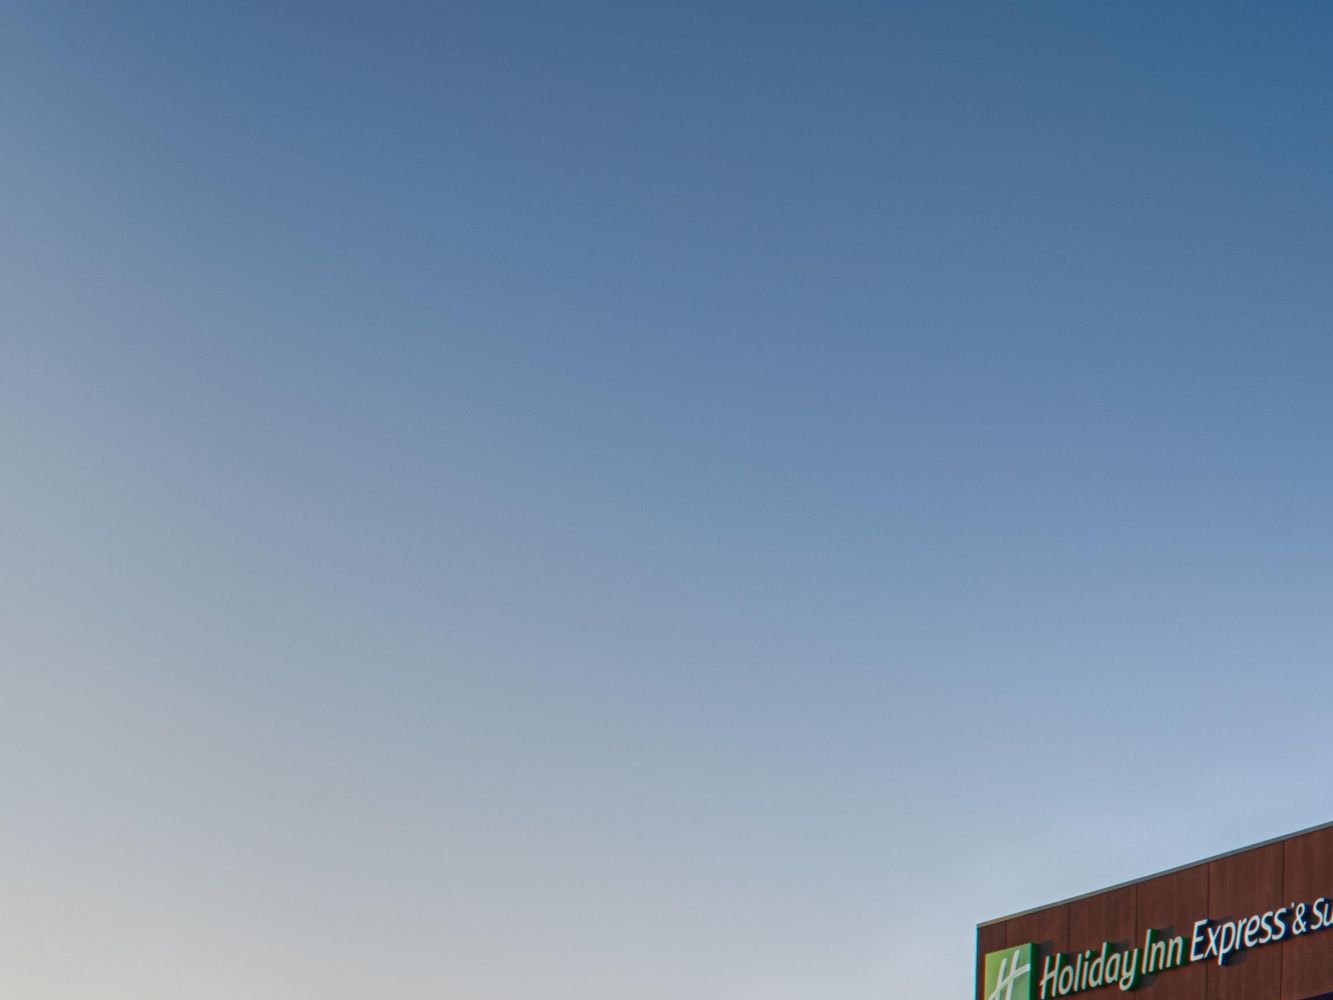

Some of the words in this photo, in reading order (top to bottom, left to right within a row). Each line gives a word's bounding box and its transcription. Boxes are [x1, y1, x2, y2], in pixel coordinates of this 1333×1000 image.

[1039, 942, 1138, 1000] Holiday
[1141, 928, 1184, 975] Inn
[1190, 907, 1288, 966] Express
[1292, 902, 1307, 935] &
